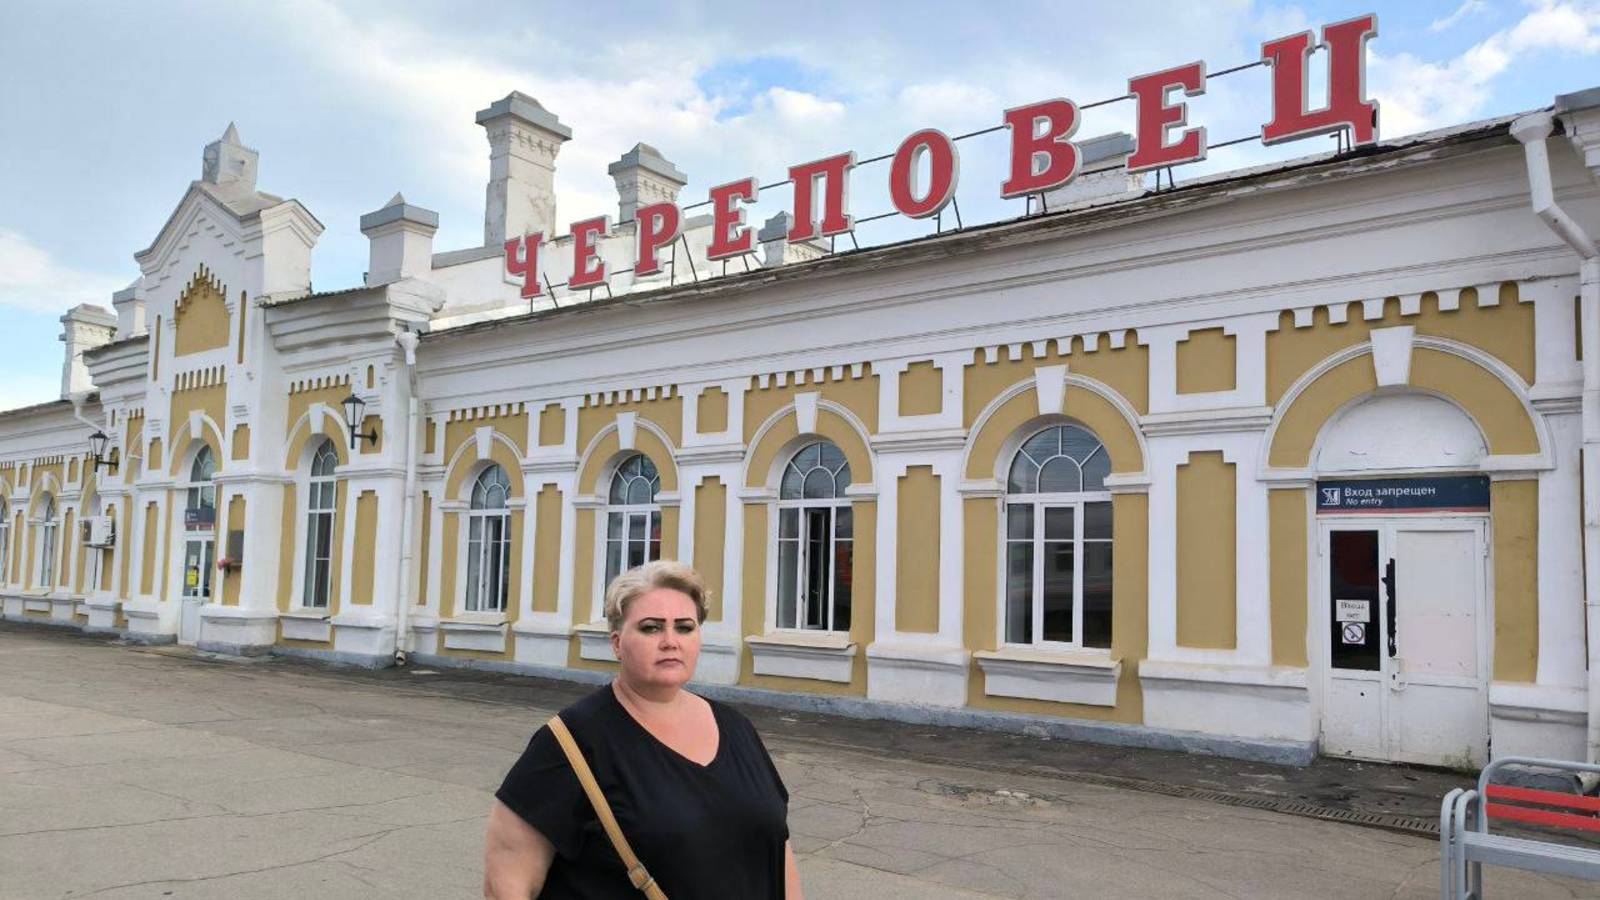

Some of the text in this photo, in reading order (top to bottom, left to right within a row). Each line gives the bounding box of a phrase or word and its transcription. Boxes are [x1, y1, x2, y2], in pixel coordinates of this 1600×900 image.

[504, 14, 1379, 299] ЧЕРЕПОВЕЦ
[1344, 487, 1436, 497] Вход запрещен
[1361, 497, 1384, 506] entry
